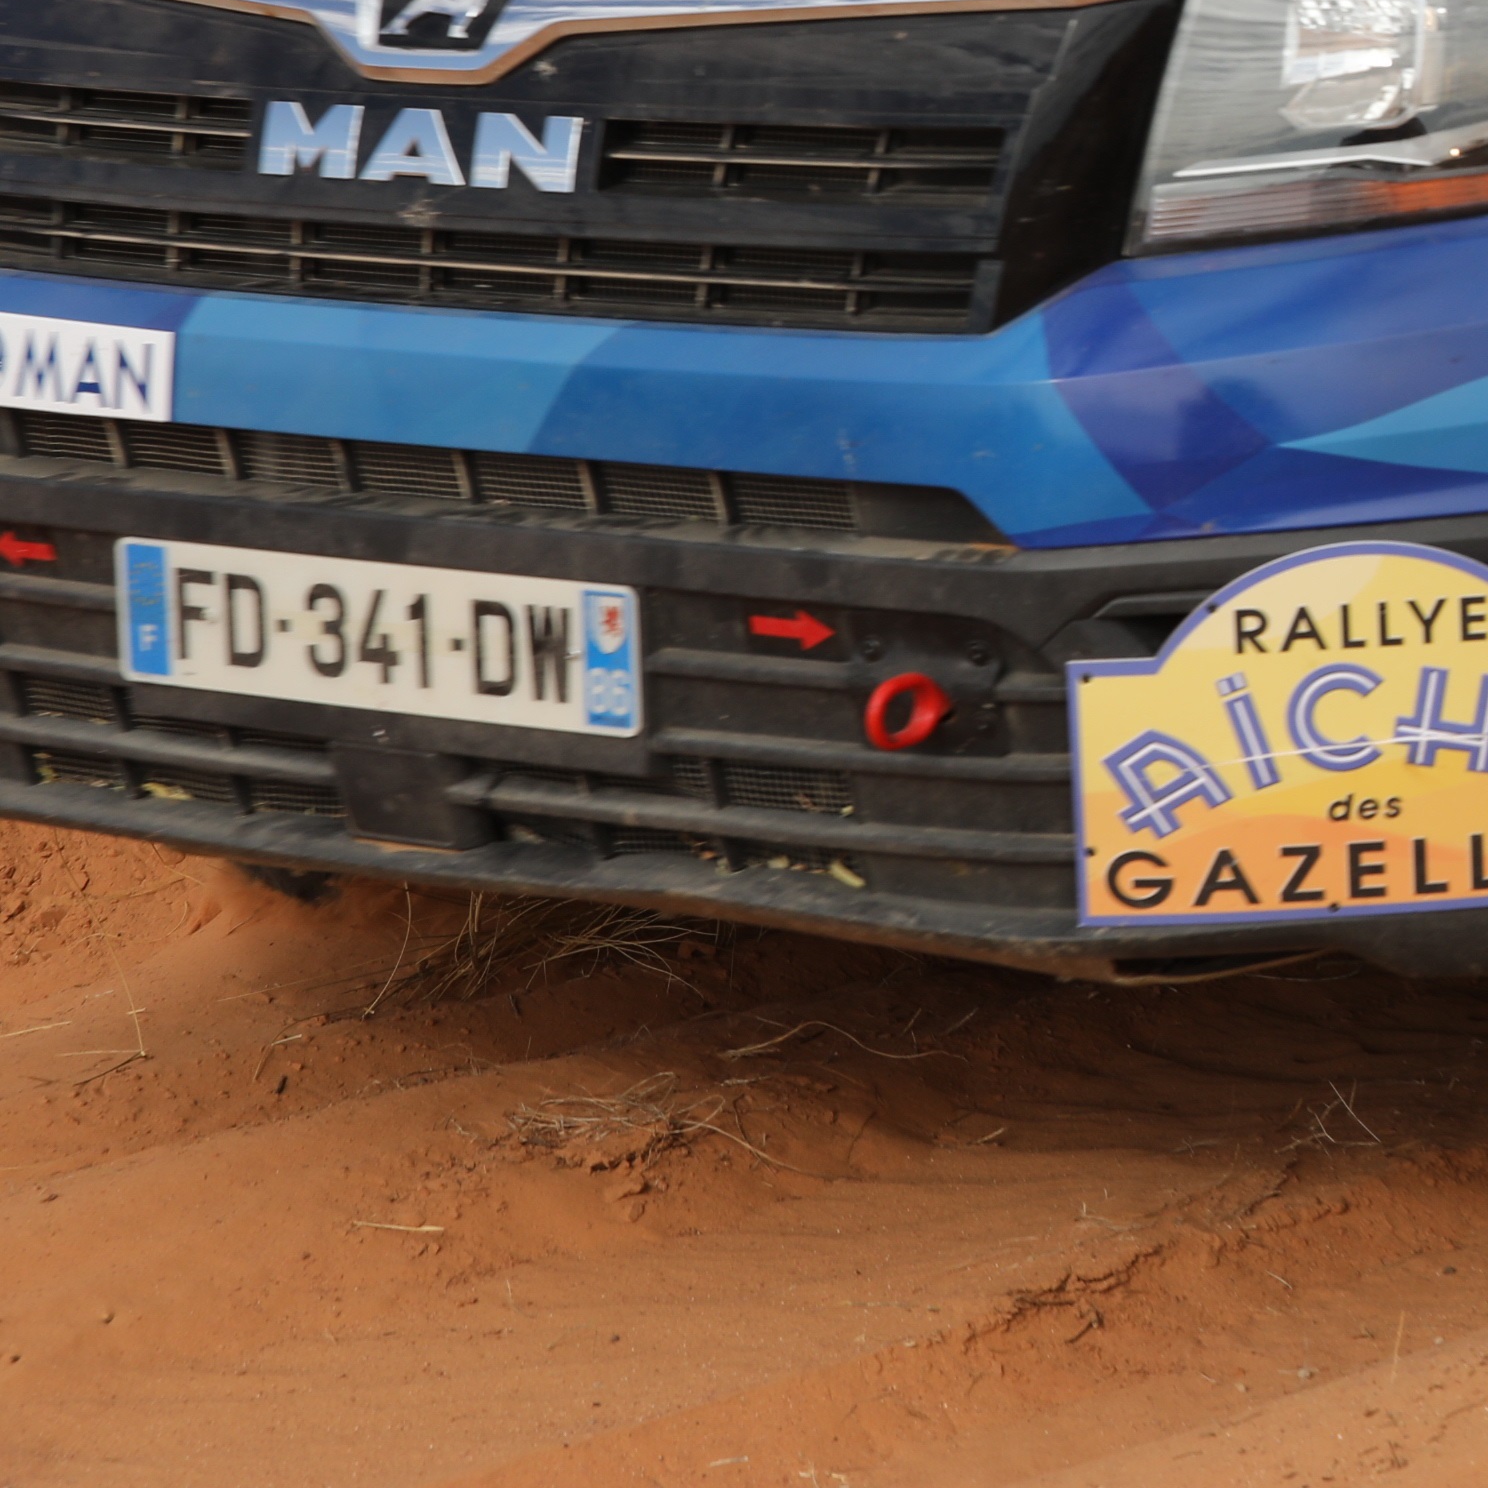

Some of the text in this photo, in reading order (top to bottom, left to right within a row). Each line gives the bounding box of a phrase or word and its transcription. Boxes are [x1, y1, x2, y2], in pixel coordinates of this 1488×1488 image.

[258, 101, 584, 193] MAN
[0, 325, 154, 413] MAN
[174, 567, 573, 704] FD-341-DW
[1235, 595, 1488, 654] RALLYE
[1328, 794, 1402, 823] des
